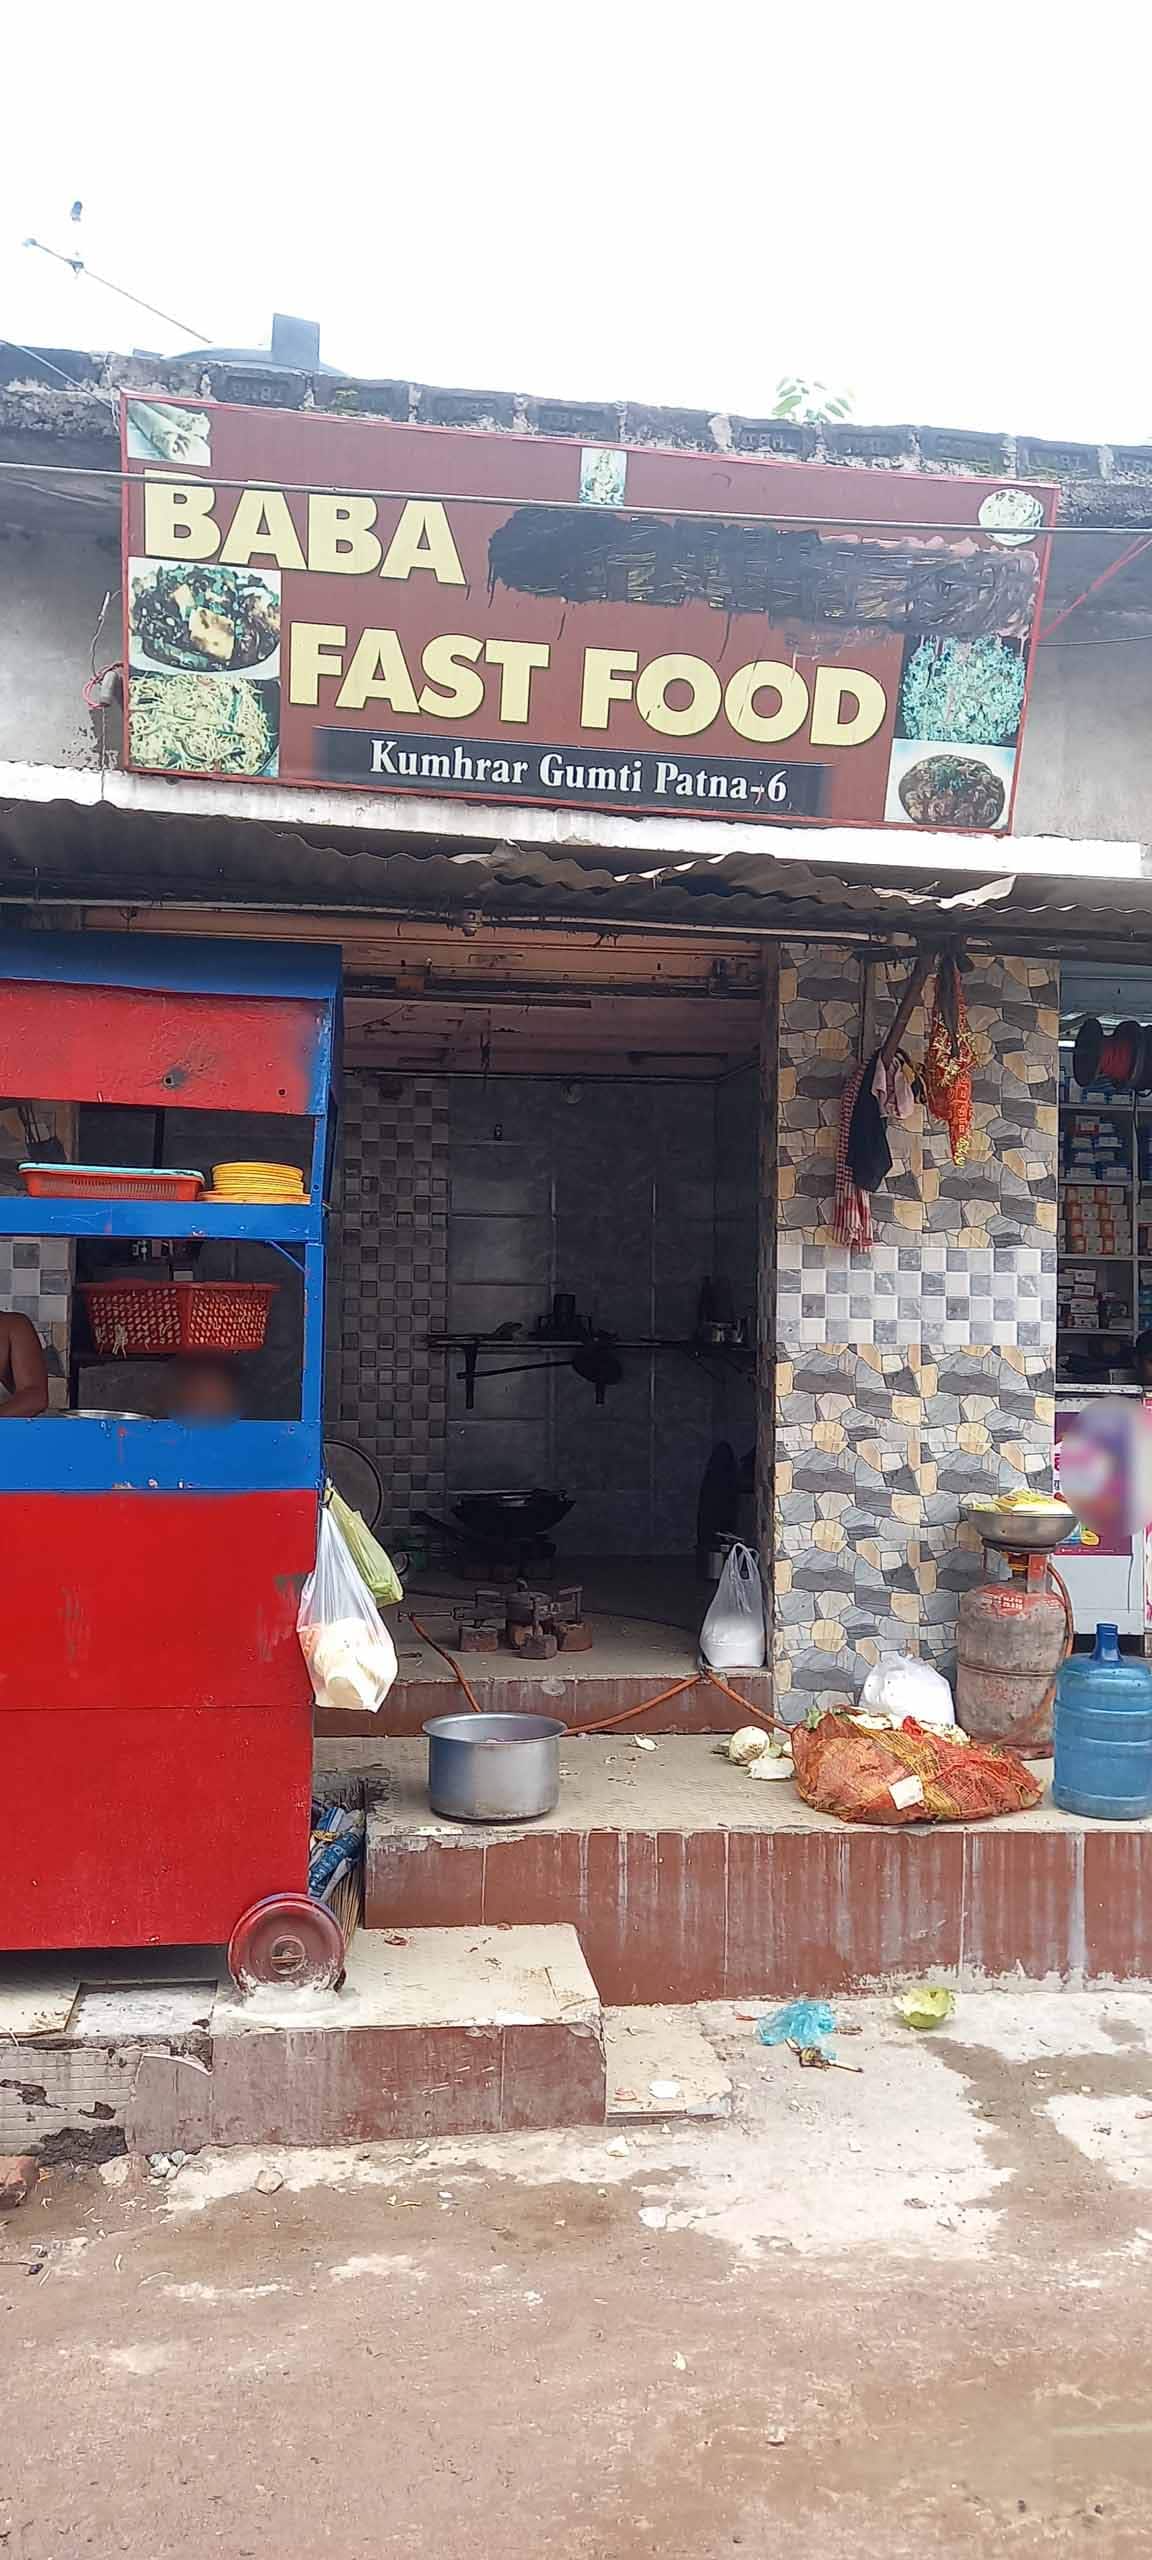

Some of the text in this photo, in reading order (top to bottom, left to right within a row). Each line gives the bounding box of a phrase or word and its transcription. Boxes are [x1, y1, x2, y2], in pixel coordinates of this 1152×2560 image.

[144, 469, 467, 586] BABA
[288, 621, 887, 747] FAST FOOD
[370, 740, 788, 803] Kumhrar Gumti Patna-6
